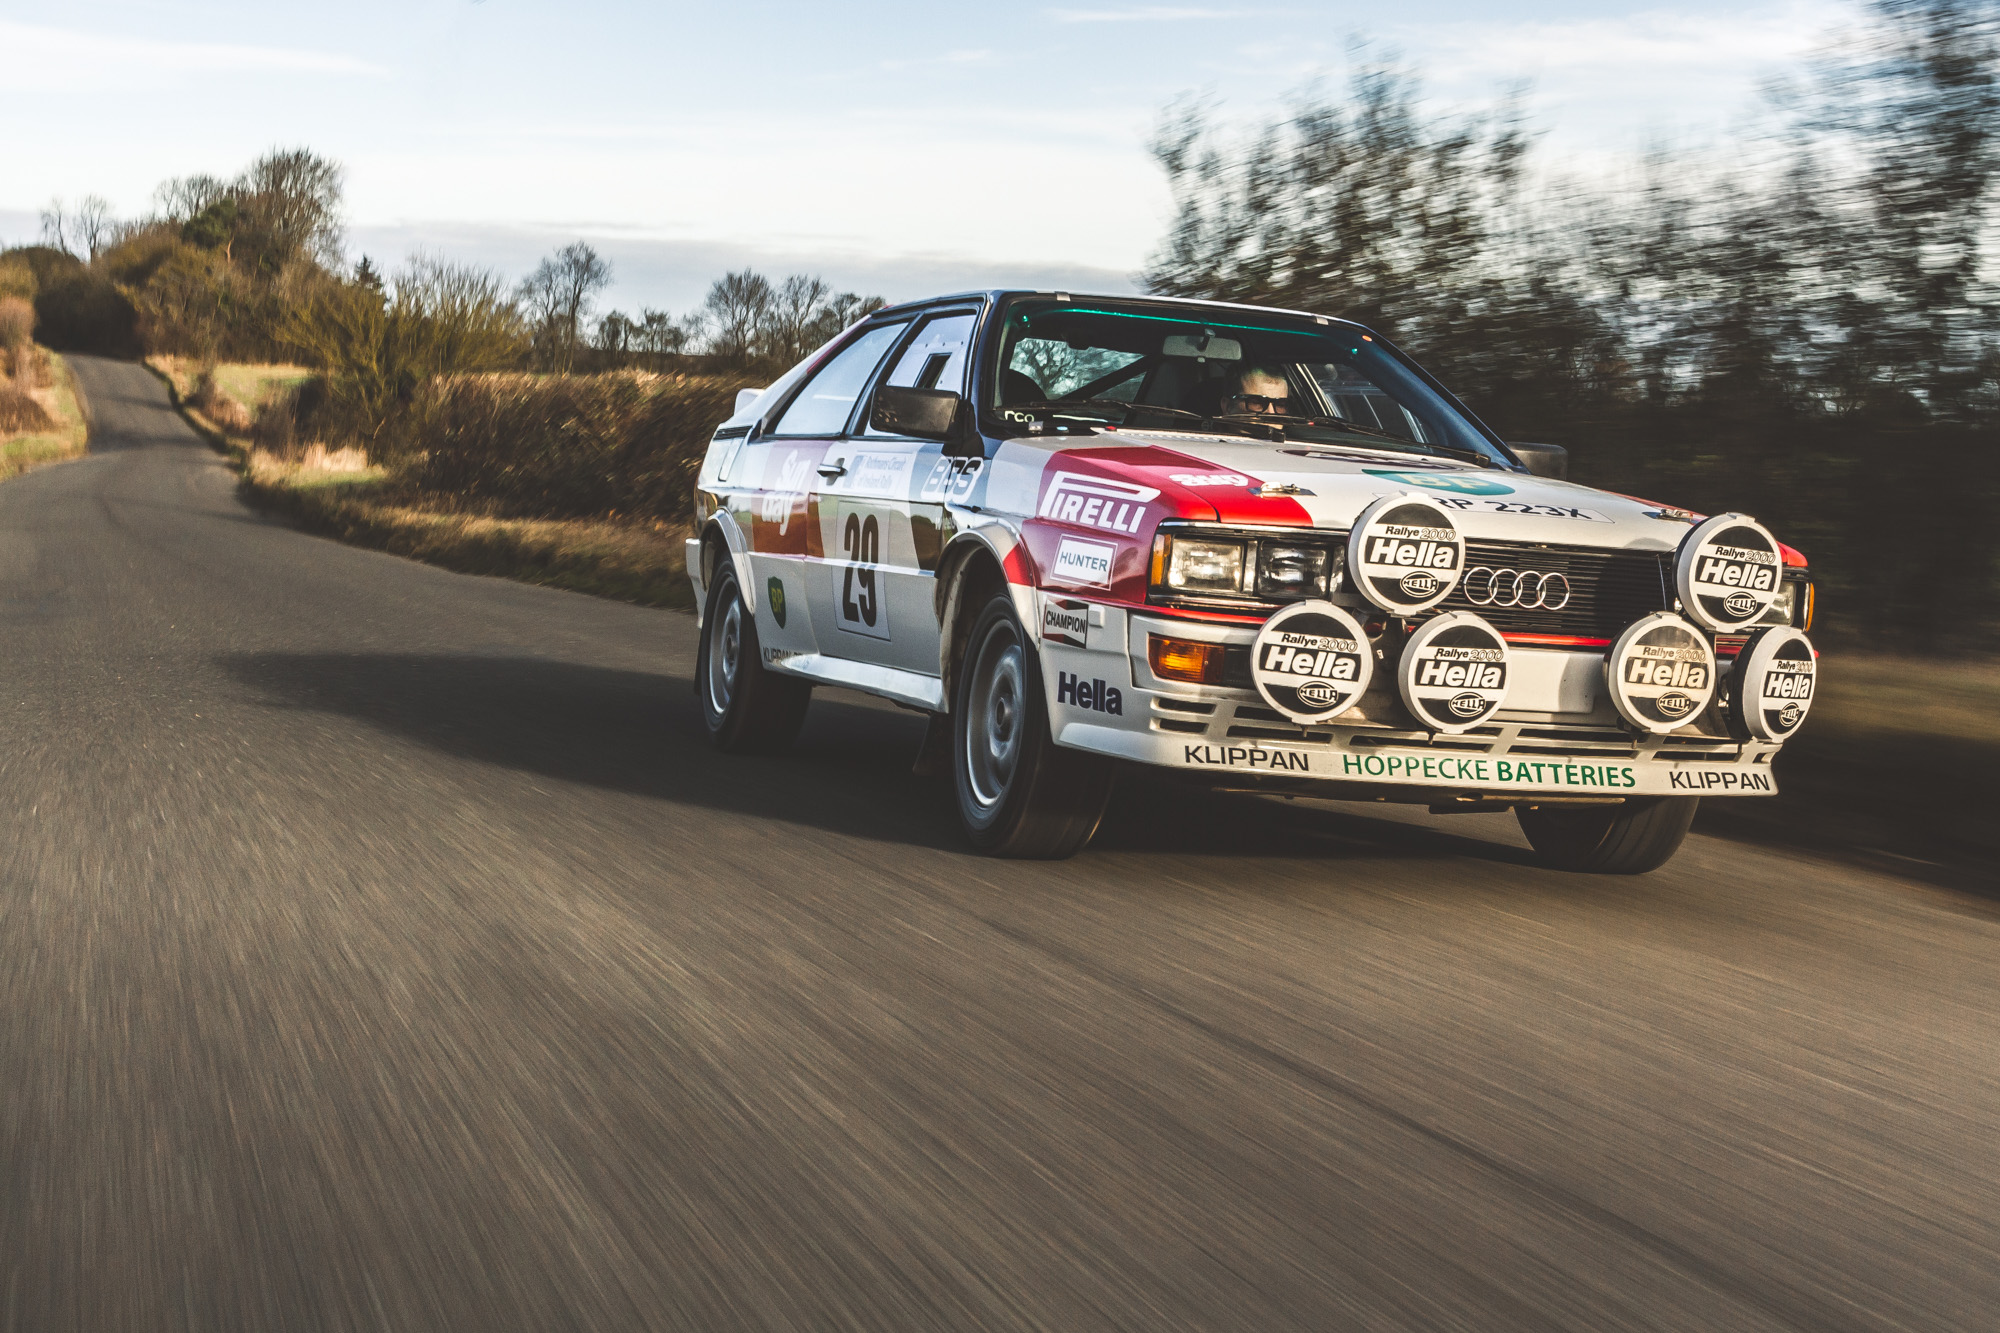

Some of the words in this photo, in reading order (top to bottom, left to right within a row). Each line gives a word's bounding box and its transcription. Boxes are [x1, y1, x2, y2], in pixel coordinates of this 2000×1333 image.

[1397, 473, 1489, 489] BP
[1039, 470, 1161, 533] PIRELLI
[1484, 500, 1592, 519] 223X
[1385, 526, 1420, 538] Rallye
[1420, 528, 1456, 541] 2000
[1060, 551, 1108, 572] HUNTER
[1369, 538, 1455, 568] Hella
[1715, 546, 1745, 560] Rallye
[1745, 550, 1776, 564] 2000
[842, 512, 879, 628] 29
[1700, 558, 1773, 590] Hella
[1403, 578, 1438, 590] HELLA
[771, 587, 783, 613] BP
[1727, 598, 1757, 611] HELLA
[1045, 610, 1086, 634] CHAMPION
[1281, 633, 1318, 647] Rallye
[1318, 638, 1358, 653] 2000
[1265, 645, 1356, 680] Hella
[1435, 648, 1469, 660] Rallye
[1469, 649, 1504, 661] 2000
[1643, 646, 1675, 659] Rallye
[1675, 650, 1706, 662] 2000
[1420, 660, 1502, 688] Hella
[1628, 658, 1706, 688] Hella
[1777, 660, 1796, 672] Rallye
[1058, 671, 1123, 716] Hella
[1300, 688, 1338, 701] HELLA
[1765, 673, 1811, 698] Hella
[1452, 698, 1485, 710] HELLA
[1660, 698, 1691, 709] HELLA
[1184, 745, 1309, 771] KLIPPAN
[1343, 754, 1490, 781] HOPPECKE
[1496, 761, 1636, 788] BATTERIES
[1669, 770, 1770, 791] KLIPPAN
